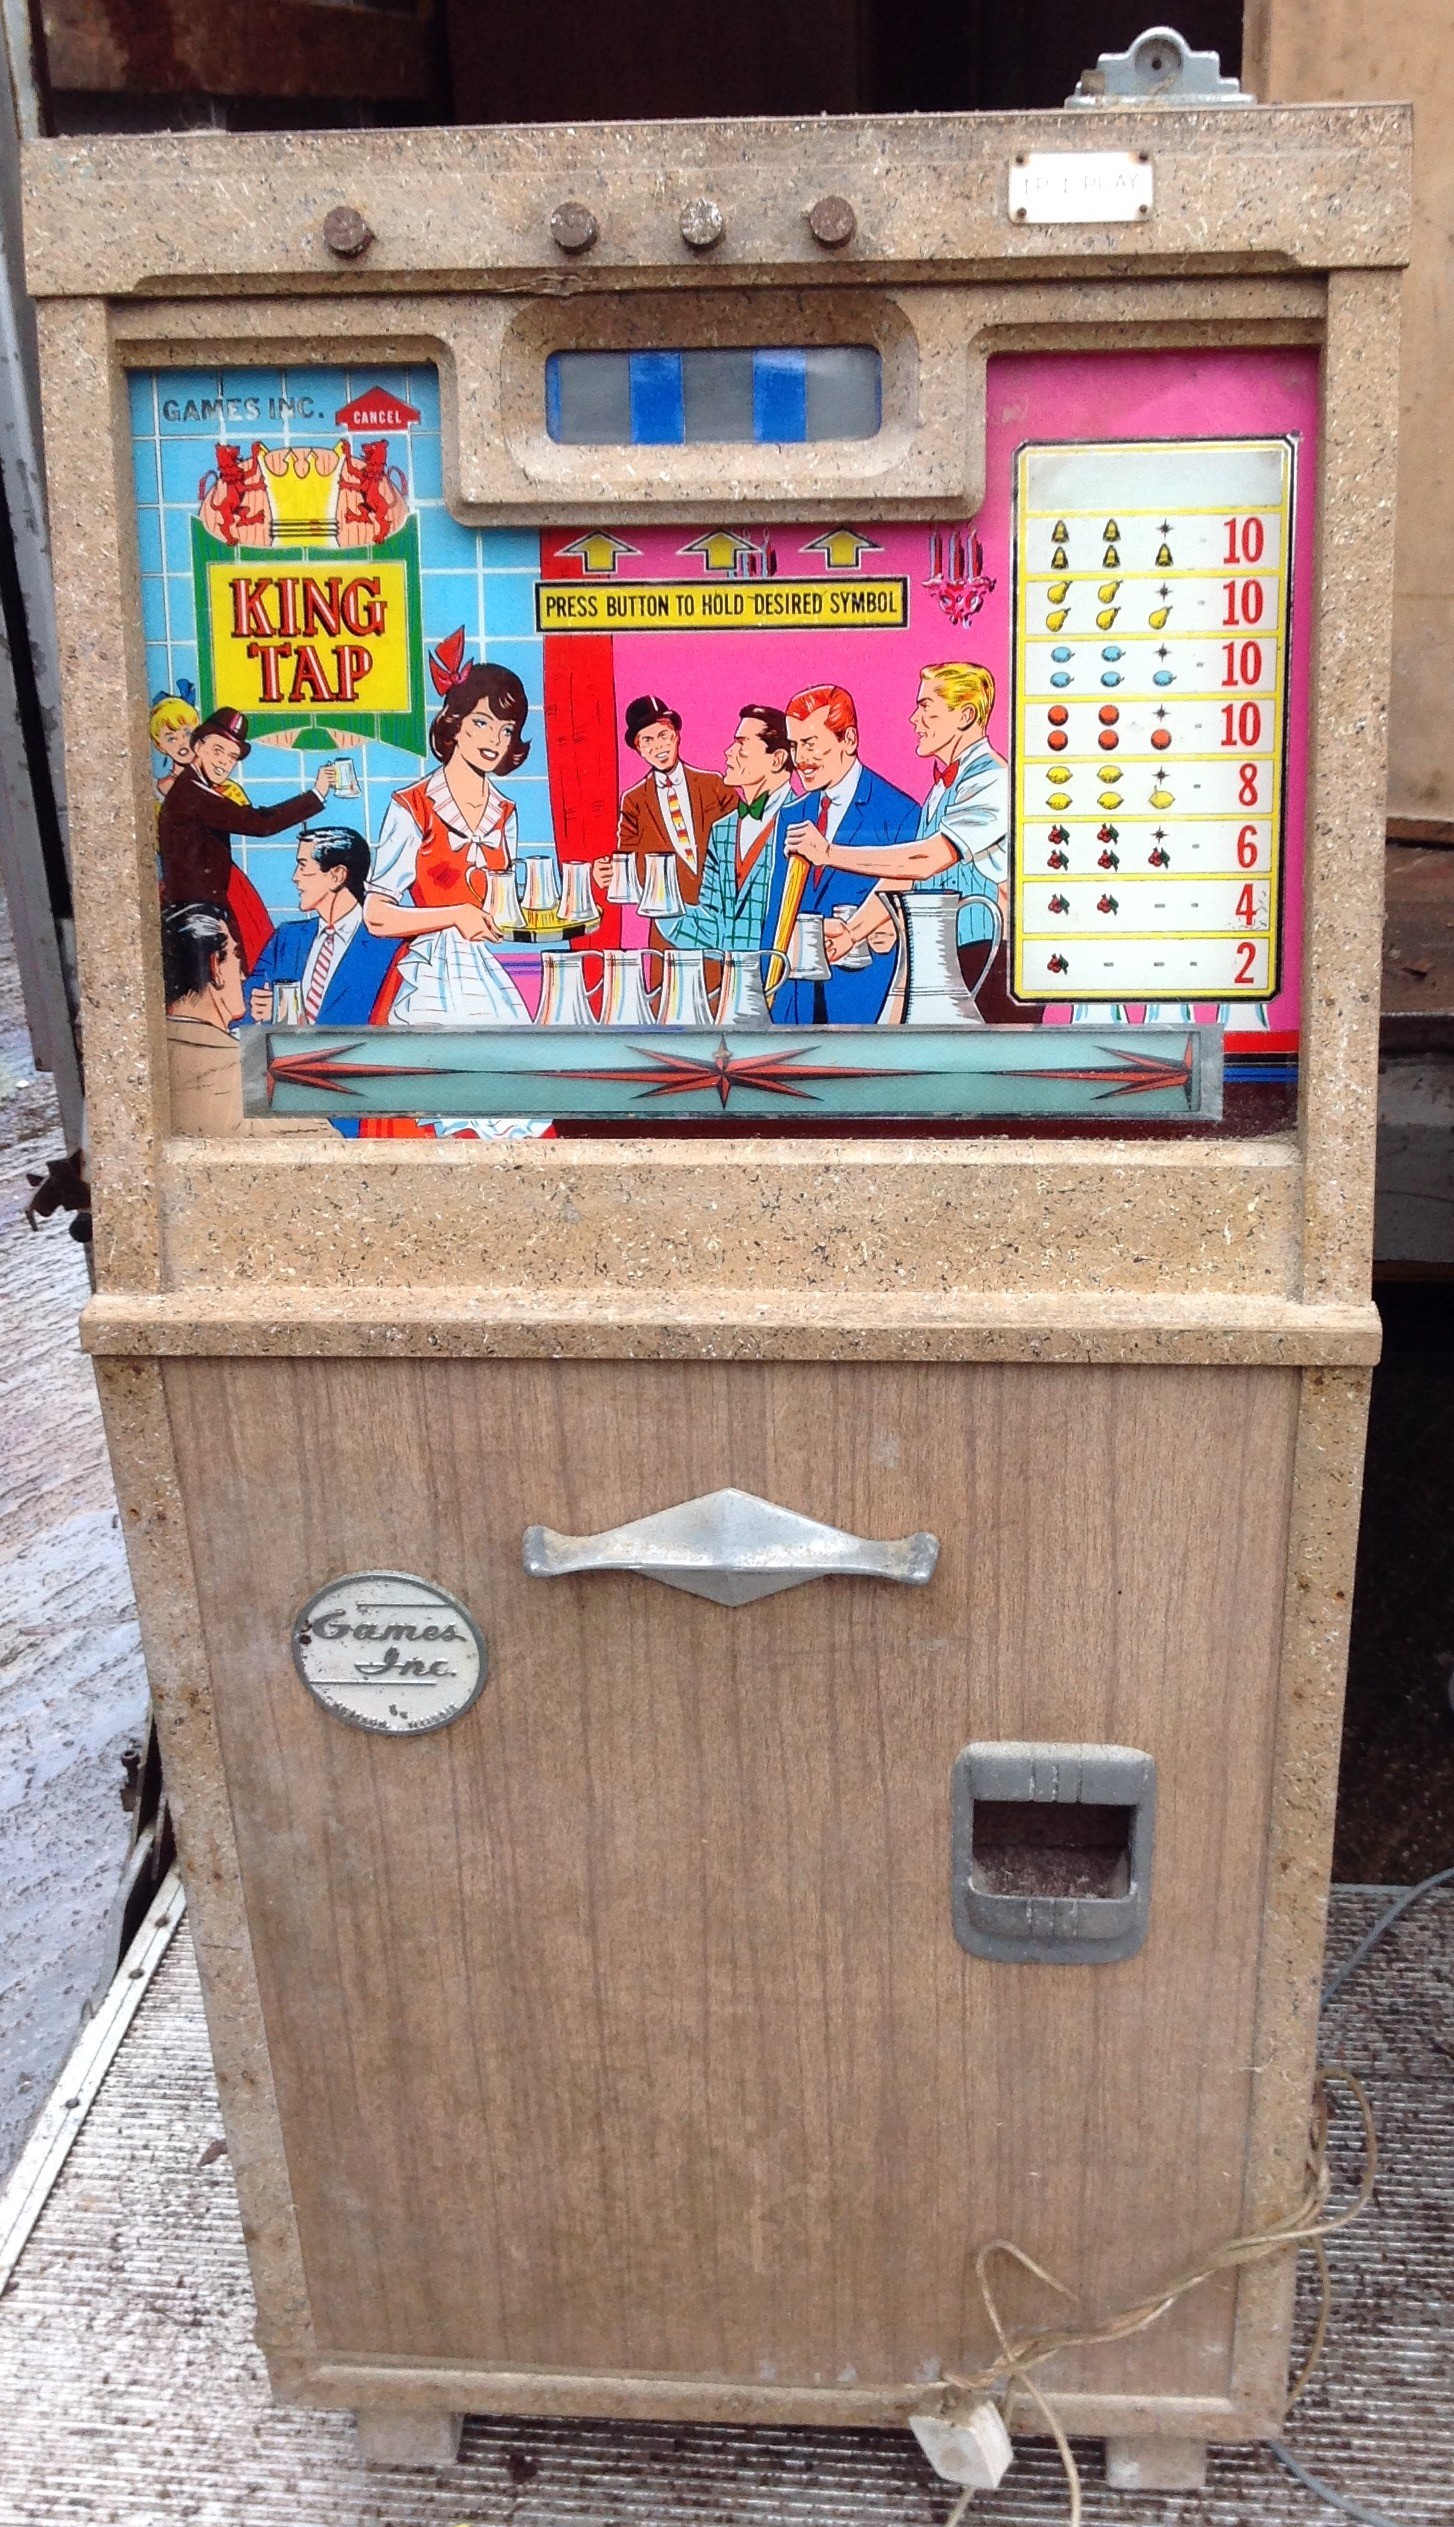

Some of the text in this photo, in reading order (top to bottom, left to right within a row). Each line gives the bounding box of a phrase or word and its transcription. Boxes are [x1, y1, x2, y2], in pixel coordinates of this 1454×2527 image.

[1084, 172, 1139, 191] PLAY
[162, 396, 325, 422] GAMES INC.
[352, 410, 403, 425] CANCEL
[1222, 516, 1264, 564] 10
[229, 576, 388, 638] KING
[546, 591, 898, 618] PRESS BUTTON TO HOLD DESIRED SYMBOL
[1222, 579, 1263, 626] 10
[246, 642, 374, 703] TAP
[1221, 640, 1262, 686] 10
[1220, 701, 1261, 746] 10
[1238, 762, 1259, 807] 8
[1237, 824, 1258, 868] 6
[1235, 883, 1257, 926] 4
[1234, 942, 1257, 984] 2
[311, 1608, 467, 1642] Games
[354, 1646, 457, 1678] Inc.
